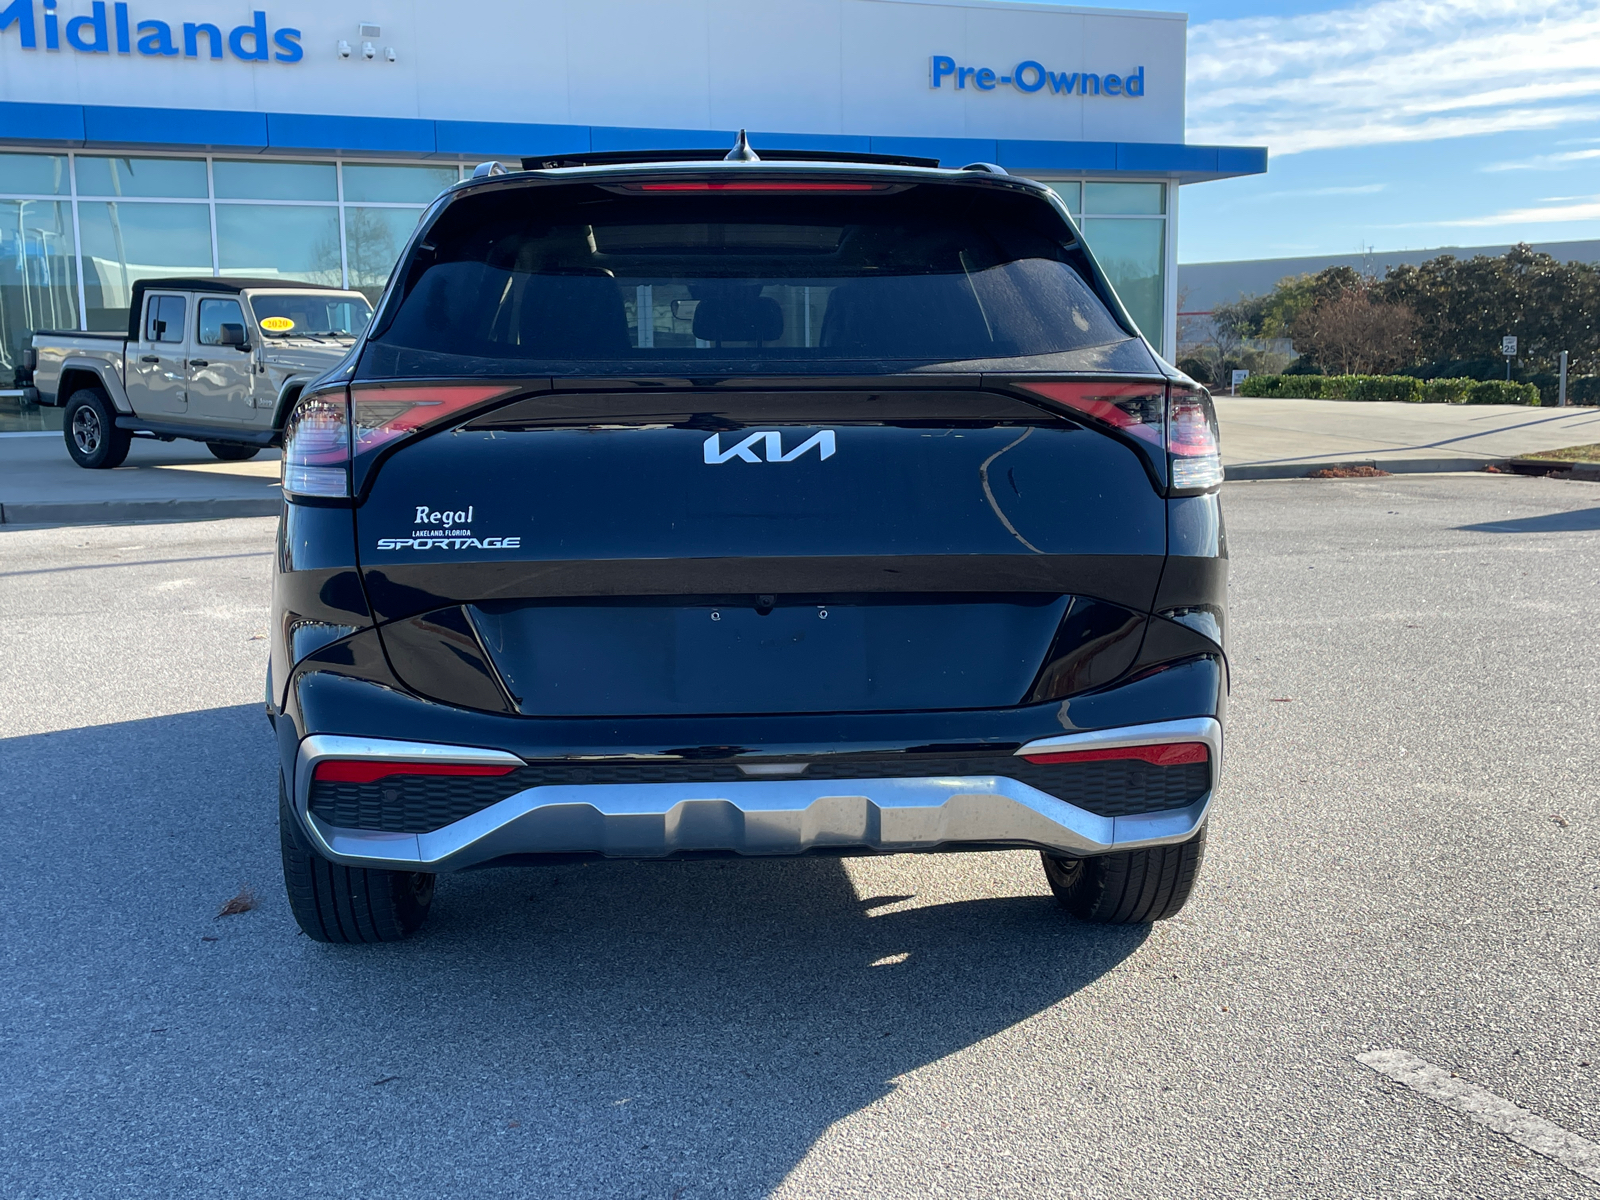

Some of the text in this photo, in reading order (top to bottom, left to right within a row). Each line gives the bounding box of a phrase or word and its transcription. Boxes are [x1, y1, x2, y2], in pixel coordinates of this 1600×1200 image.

[929, 55, 1145, 97] Pre-Owned
[266, 319, 288, 328] 2020
[1504, 345, 1516, 353] 25
[414, 505, 473, 527] Regal
[445, 529, 471, 537] FLORIDA
[376, 537, 521, 550] SPORTAGE
